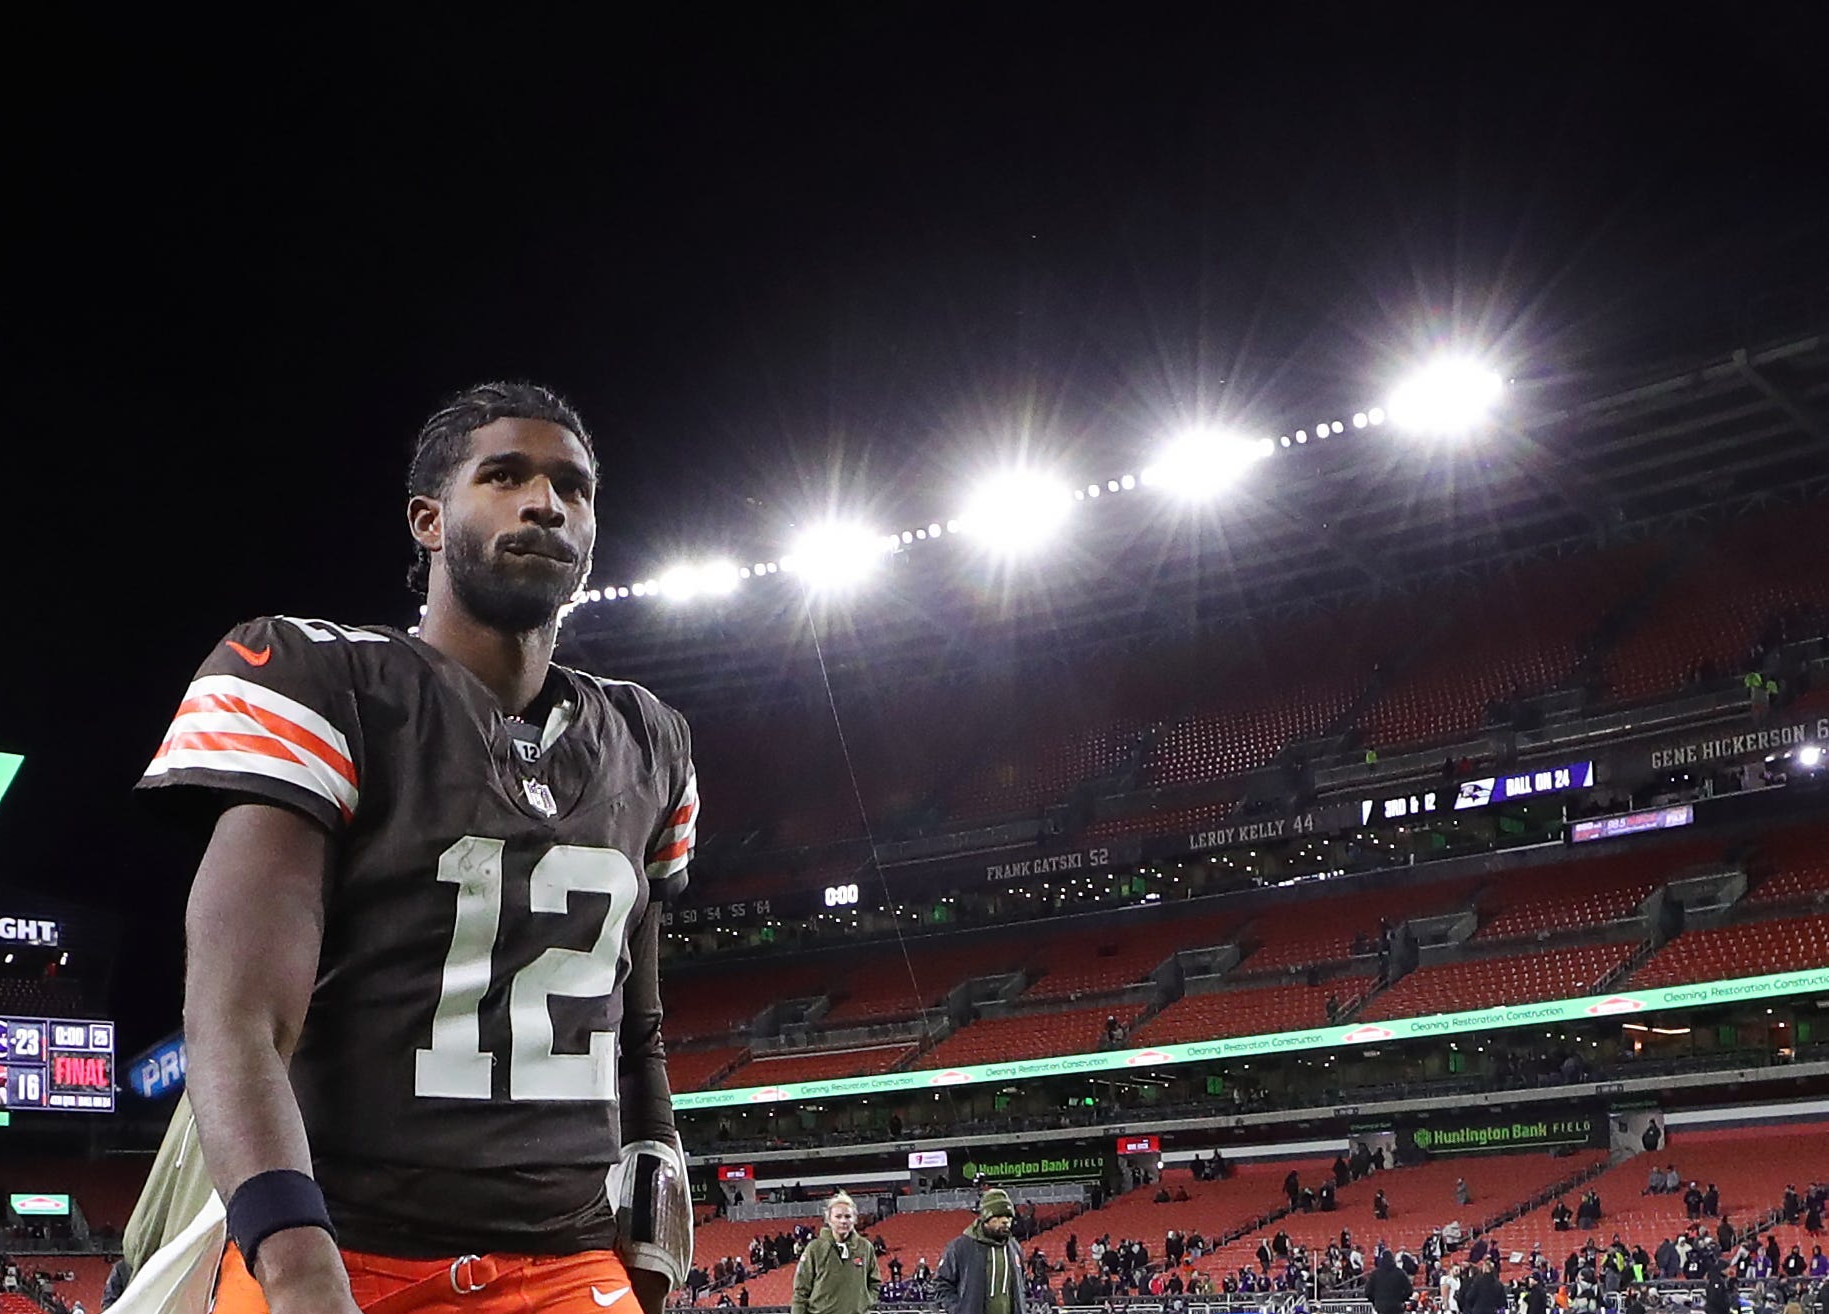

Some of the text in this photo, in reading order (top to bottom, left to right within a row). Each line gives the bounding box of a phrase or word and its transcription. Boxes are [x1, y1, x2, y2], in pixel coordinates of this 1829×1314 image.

[522, 744, 540, 760] 12
[1652, 745, 1697, 769] GENE
[1703, 724, 1805, 760] HICKERSON
[1506, 768, 1570, 797] BALL ON 24
[1384, 798, 1406, 818] 3RD
[1190, 813, 1313, 850] LEROY KELLY 44
[986, 848, 1108, 881] FRANK GATSKI 52
[825, 884, 858, 907] 0:00
[415, 835, 639, 1100] 12
[1664, 989, 1707, 1002] Cleaning
[1711, 982, 1770, 996] Restoration
[1411, 1006, 1564, 1033] Cleaning Restoration Construction
[15, 1029, 39, 1055] 23
[55, 1026, 85, 1046] 0:00
[94, 1030, 108, 1046] 25
[1223, 1040, 1269, 1052] Restoration
[1272, 1034, 1323, 1047] Construction
[54, 1057, 109, 1087] FINAL
[18, 1074, 40, 1100] 16
[1434, 1121, 1591, 1146] Huntington Bank FIELD
[979, 1157, 1104, 1178] Huntington Bank FIELD
